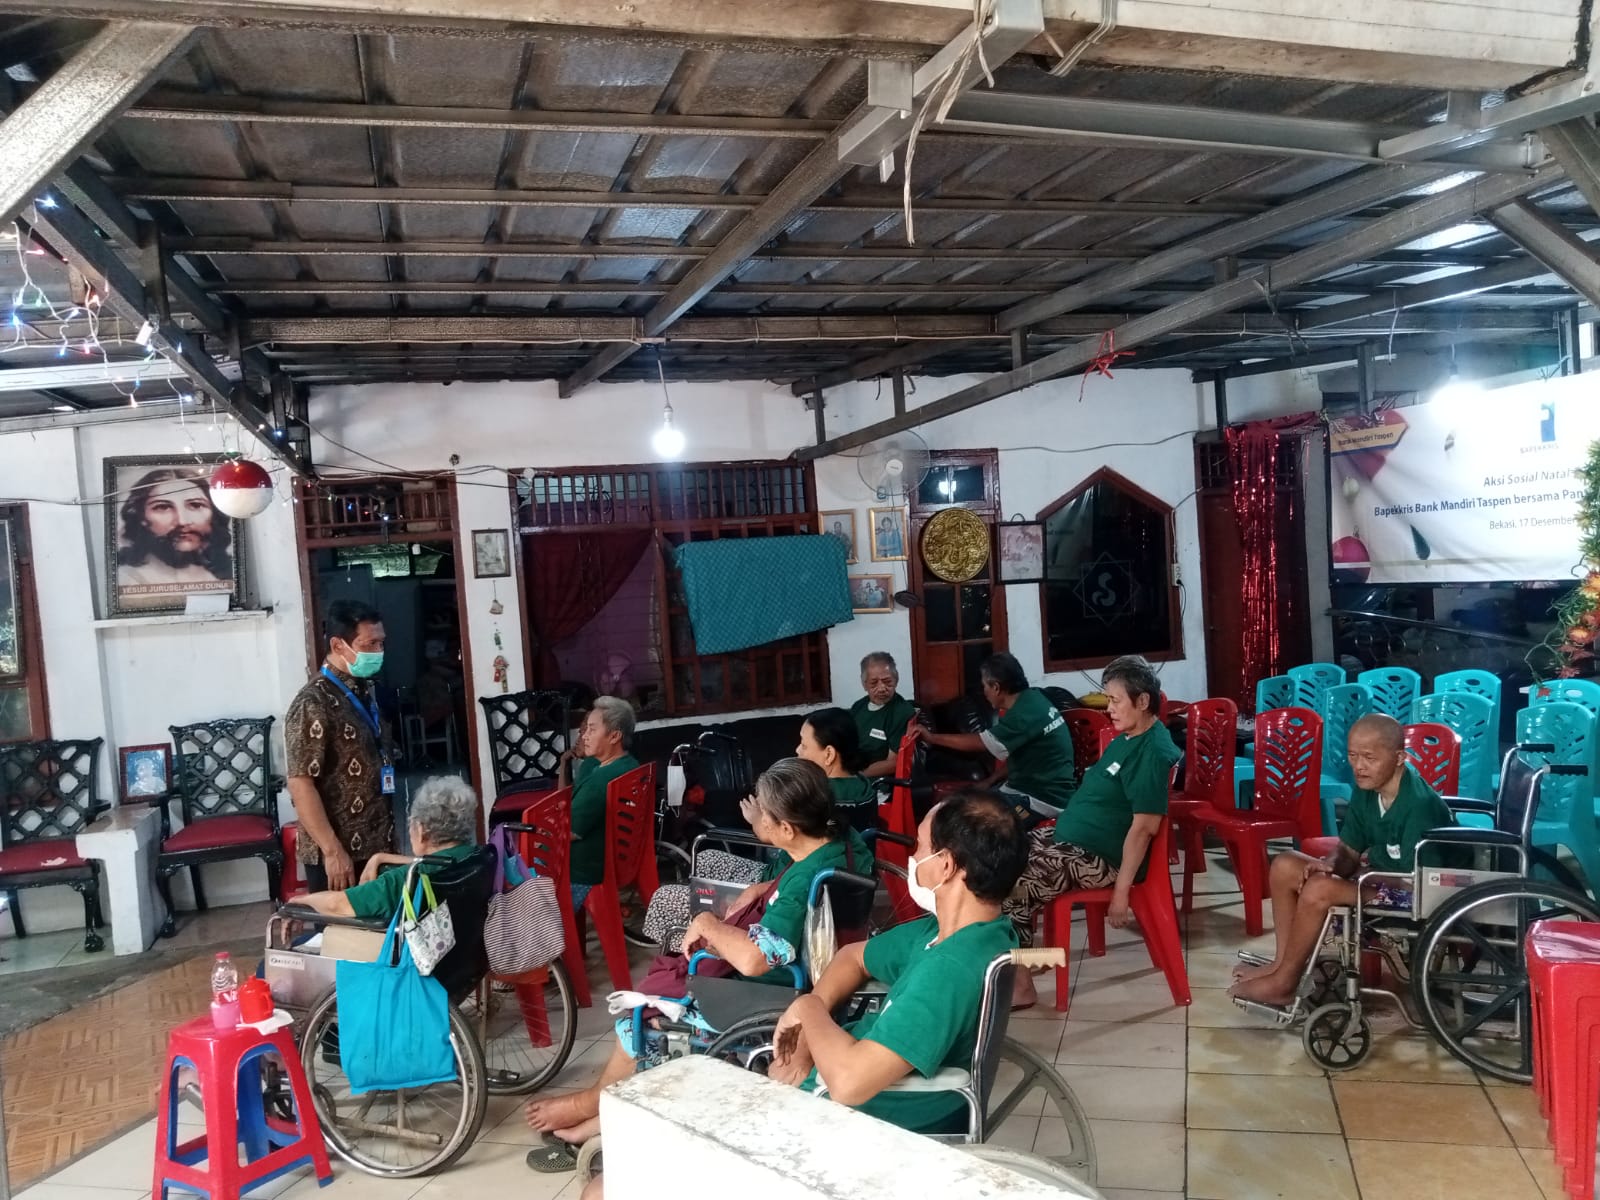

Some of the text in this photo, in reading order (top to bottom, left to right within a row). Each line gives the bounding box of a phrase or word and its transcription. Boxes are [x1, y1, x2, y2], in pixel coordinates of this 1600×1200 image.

[1374, 432, 1394, 440] Taspen
[1483, 468, 1571, 487] Aksi Sosial Natal
[1374, 489, 1584, 517] Bapekkris Bank Mandiri Taspen bersama Pan
[1519, 518, 1529, 527] 17
[1531, 515, 1576, 527] Desember
[122, 586, 146, 594] YESUS
